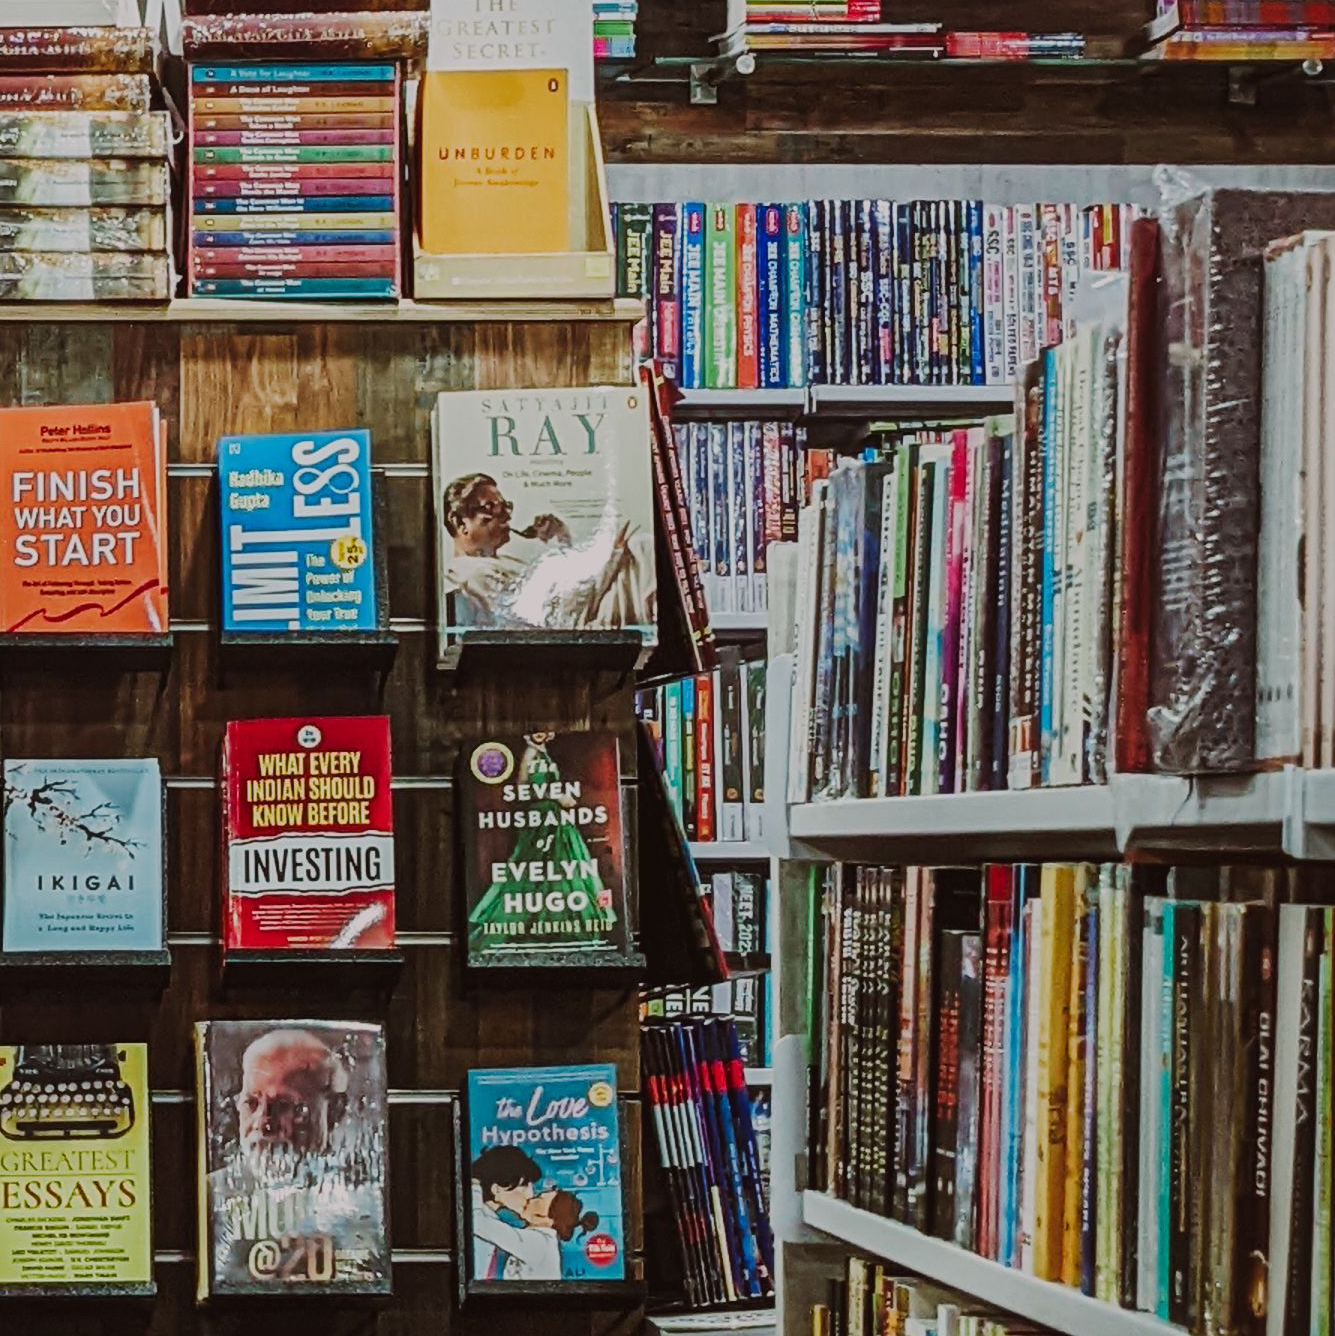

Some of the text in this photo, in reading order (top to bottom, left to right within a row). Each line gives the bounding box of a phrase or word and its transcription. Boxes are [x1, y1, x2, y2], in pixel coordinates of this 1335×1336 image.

[436, 19, 555, 36] GREATEST
[438, 147, 555, 161] UNBURDEN
[481, 396, 608, 412] SATYAJIT
[40, 423, 111, 436] Peter Hollins
[487, 414, 607, 456] RAY
[11, 467, 140, 503] FINISH
[229, 492, 270, 511] Gupta
[14, 504, 141, 529] WHAT YOU
[14, 531, 141, 567] START
[259, 751, 361, 776] WHAT EVERY
[247, 777, 375, 802] INDIAN SHOULD
[503, 782, 581, 802] SEVEN
[252, 801, 370, 827] KNOW BEFORE
[479, 807, 607, 828] HUSBANDS
[536, 834, 554, 852] of
[244, 846, 381, 883] INVESTING
[491, 859, 599, 883] EVELYN
[37, 874, 136, 891] IKIGAI
[504, 892, 588, 913] HUGO
[526, 1086, 589, 1126] Love
[482, 1121, 610, 1146] Hypothesis
[0, 1149, 135, 1172] GREATEST
[1, 1179, 137, 1210] ESSAYS
[249, 1235, 334, 1282] @20
